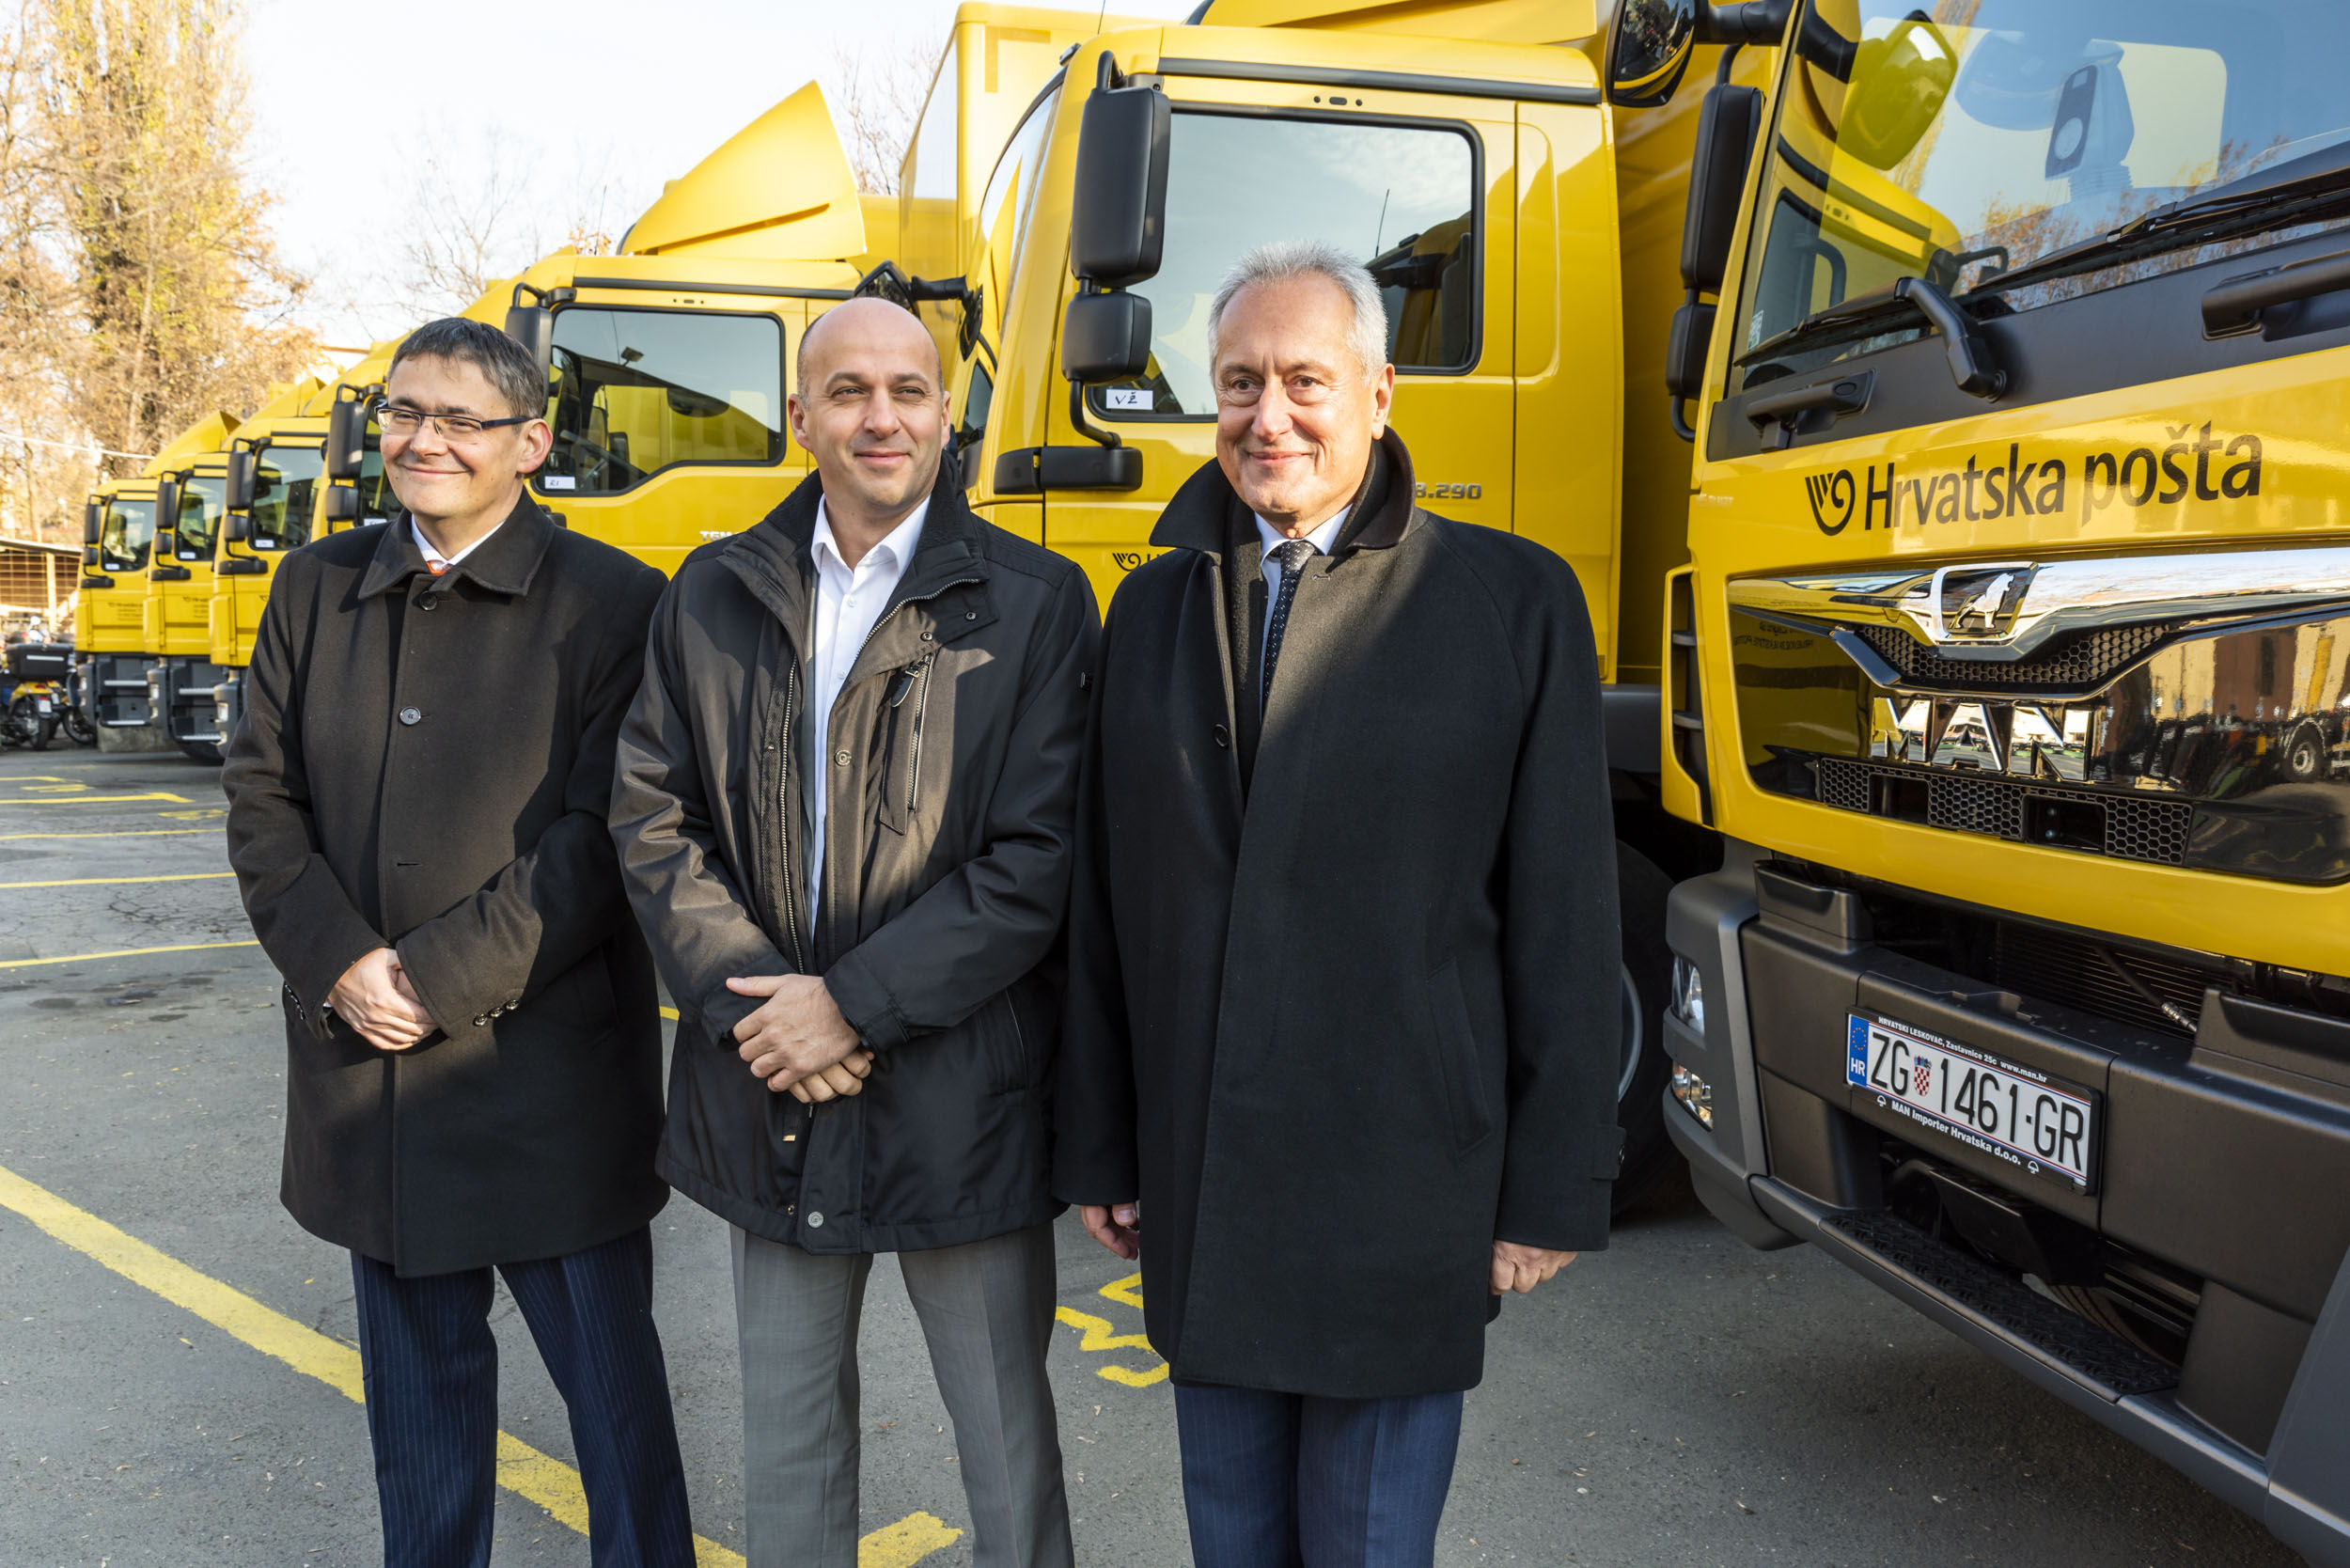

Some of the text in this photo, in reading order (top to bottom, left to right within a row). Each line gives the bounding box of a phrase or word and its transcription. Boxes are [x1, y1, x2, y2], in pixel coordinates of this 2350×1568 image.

[1865, 420, 2263, 530] Hrvatska pošta
[1871, 698, 2091, 781] MAN
[1851, 1057, 1866, 1077] HR
[1870, 1031, 1911, 1096] ZG
[1878, 1016, 2048, 1083] HRVATSKI LESKOVAC, Zastavnice 25c www.man.hr
[1891, 1100, 2022, 1166] MAN Importer Hrvatska d.o.o.
